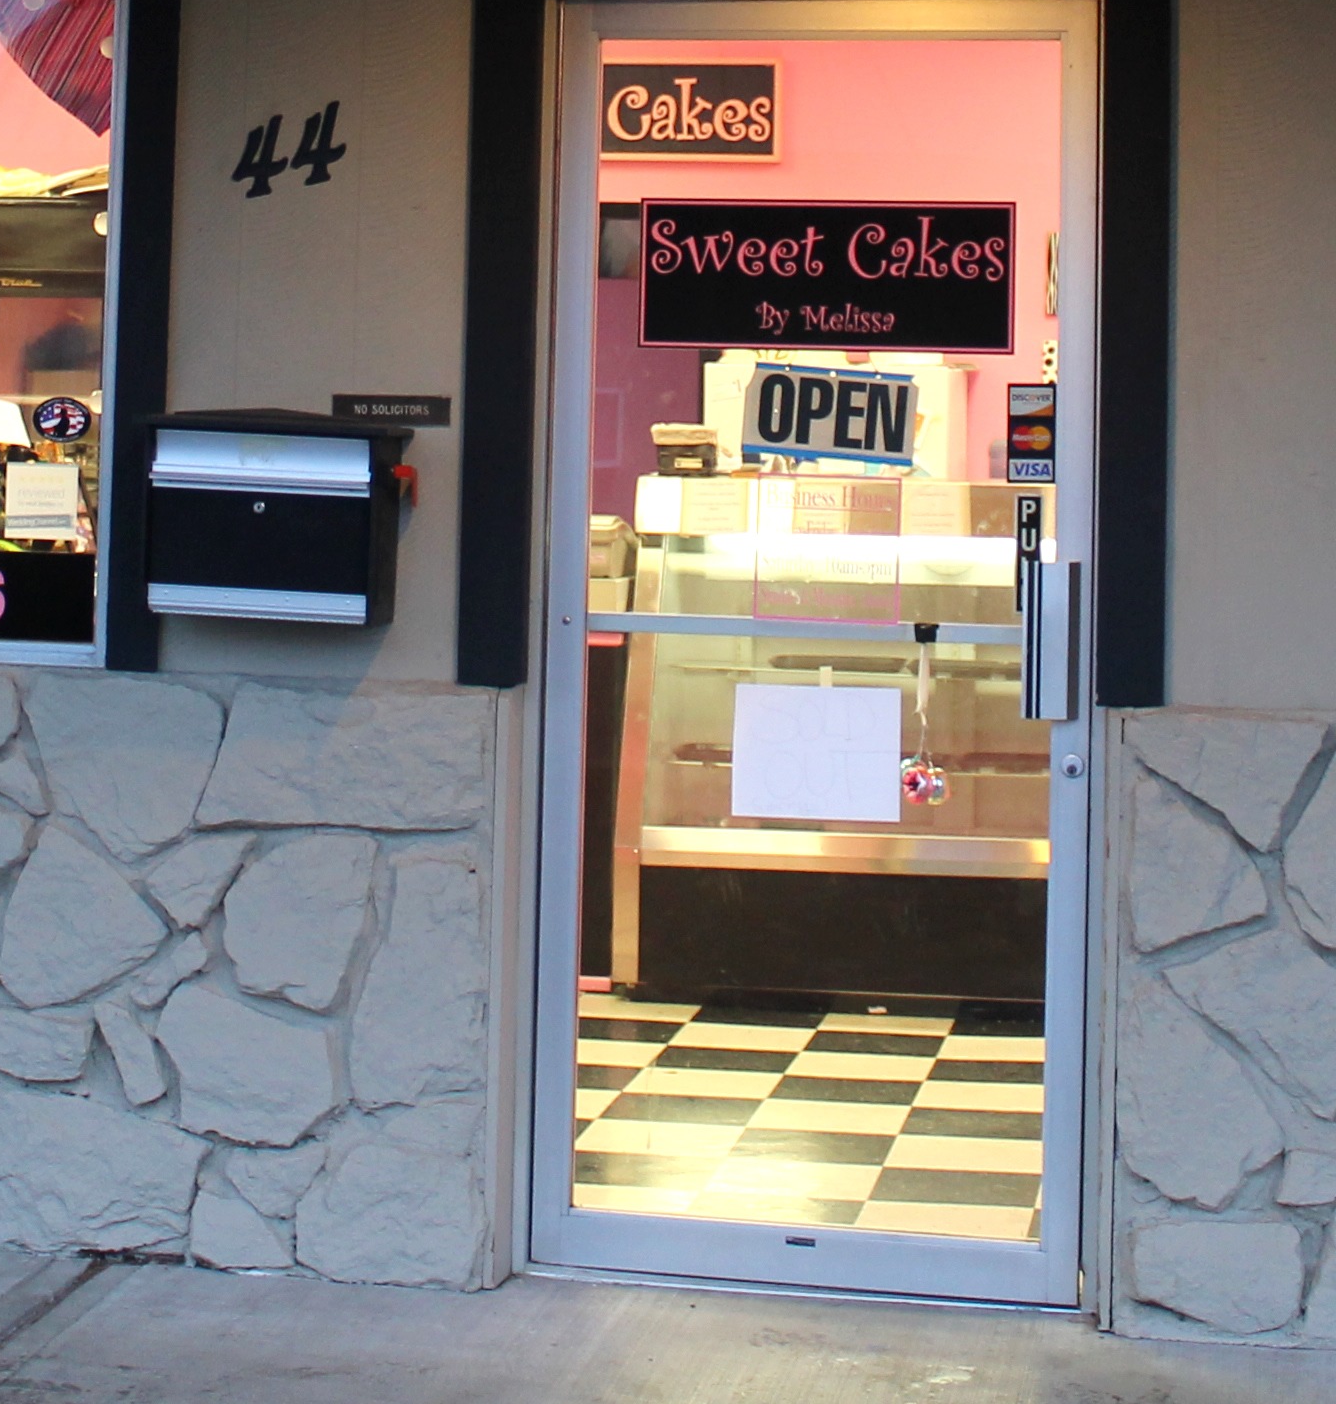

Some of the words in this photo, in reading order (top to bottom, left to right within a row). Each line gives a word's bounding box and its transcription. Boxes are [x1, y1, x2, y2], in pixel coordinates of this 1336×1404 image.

[607, 78, 772, 143] Cakes
[230, 100, 346, 199] 44
[650, 218, 825, 277] Sweet
[847, 216, 1006, 282] Cakes
[755, 300, 791, 336] By
[799, 302, 896, 334] Melissa
[354, 404, 368, 415] NO
[371, 404, 431, 416] SOLICITORS
[757, 373, 909, 453] OPEN
[1011, 394, 1052, 402] DISCOVER
[1013, 463, 1052, 476] VISA
